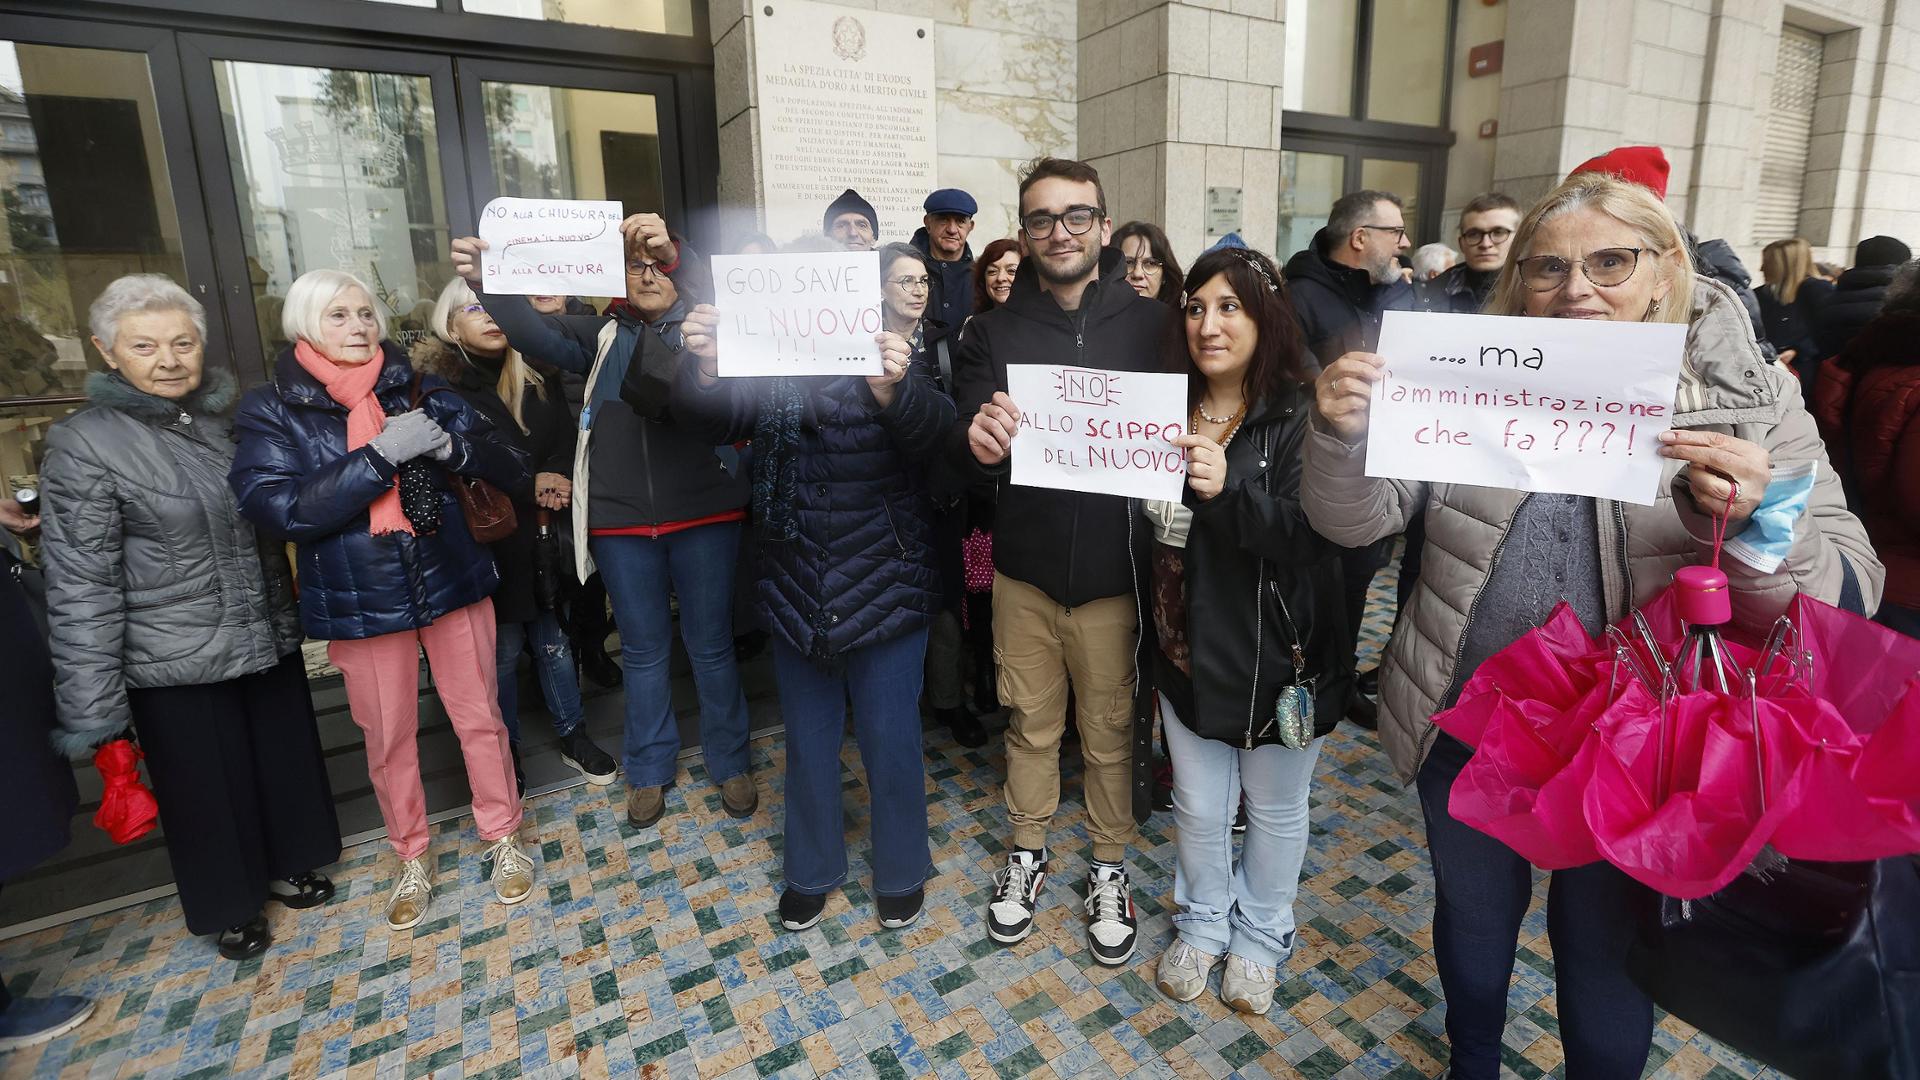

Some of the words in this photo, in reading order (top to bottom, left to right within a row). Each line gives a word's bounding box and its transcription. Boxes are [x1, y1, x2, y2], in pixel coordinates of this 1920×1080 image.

[784, 64, 797, 73] LA
[799, 64, 832, 77] SPEZIA
[865, 72, 874, 82] DI
[876, 73, 912, 85] EXODUS
[766, 75, 817, 89] MEDAGLIA
[820, 80, 848, 92] D'ORO
[850, 83, 862, 93] AL
[864, 84, 898, 97] MERITO
[900, 88, 928, 99] CIVILE
[785, 106, 800, 114] DEL
[801, 108, 835, 117] SECONDO
[825, 120, 862, 130] CRISTIANO
[864, 123, 874, 131] ED
[798, 127, 824, 136] CIVILE
[883, 133, 927, 143] PARTICOLARI
[775, 154, 812, 163] PROFUGHI
[837, 158, 870, 166] SCAMPATI
[881, 160, 902, 168] LAGER
[904, 161, 930, 170] NAZISTI
[791, 164, 841, 174] INTENDEVANO
[771, 183, 820, 192] AMMIREVOLE
[830, 176, 852, 184] TERRA
[853, 177, 889, 186] PROMESSA
[486, 207, 507, 219] NO
[513, 211, 534, 220] ALLA
[538, 208, 605, 220] CHIUSURA
[506, 236, 540, 248] CINEMA
[488, 264, 502, 276] SI
[511, 268, 533, 276] ALLA
[537, 263, 605, 275] CULTURA
[726, 267, 782, 295] GOD
[792, 265, 861, 294] SAVE
[735, 312, 759, 336] IL
[1070, 375, 1104, 399] NO
[1381, 369, 1666, 418] l'amministrazione
[1020, 411, 1073, 434] ALLO
[1085, 417, 1182, 443] SCIPPO
[1414, 419, 1472, 446] che
[1044, 447, 1080, 468] DEL
[1088, 445, 1186, 475] NUOVO!
